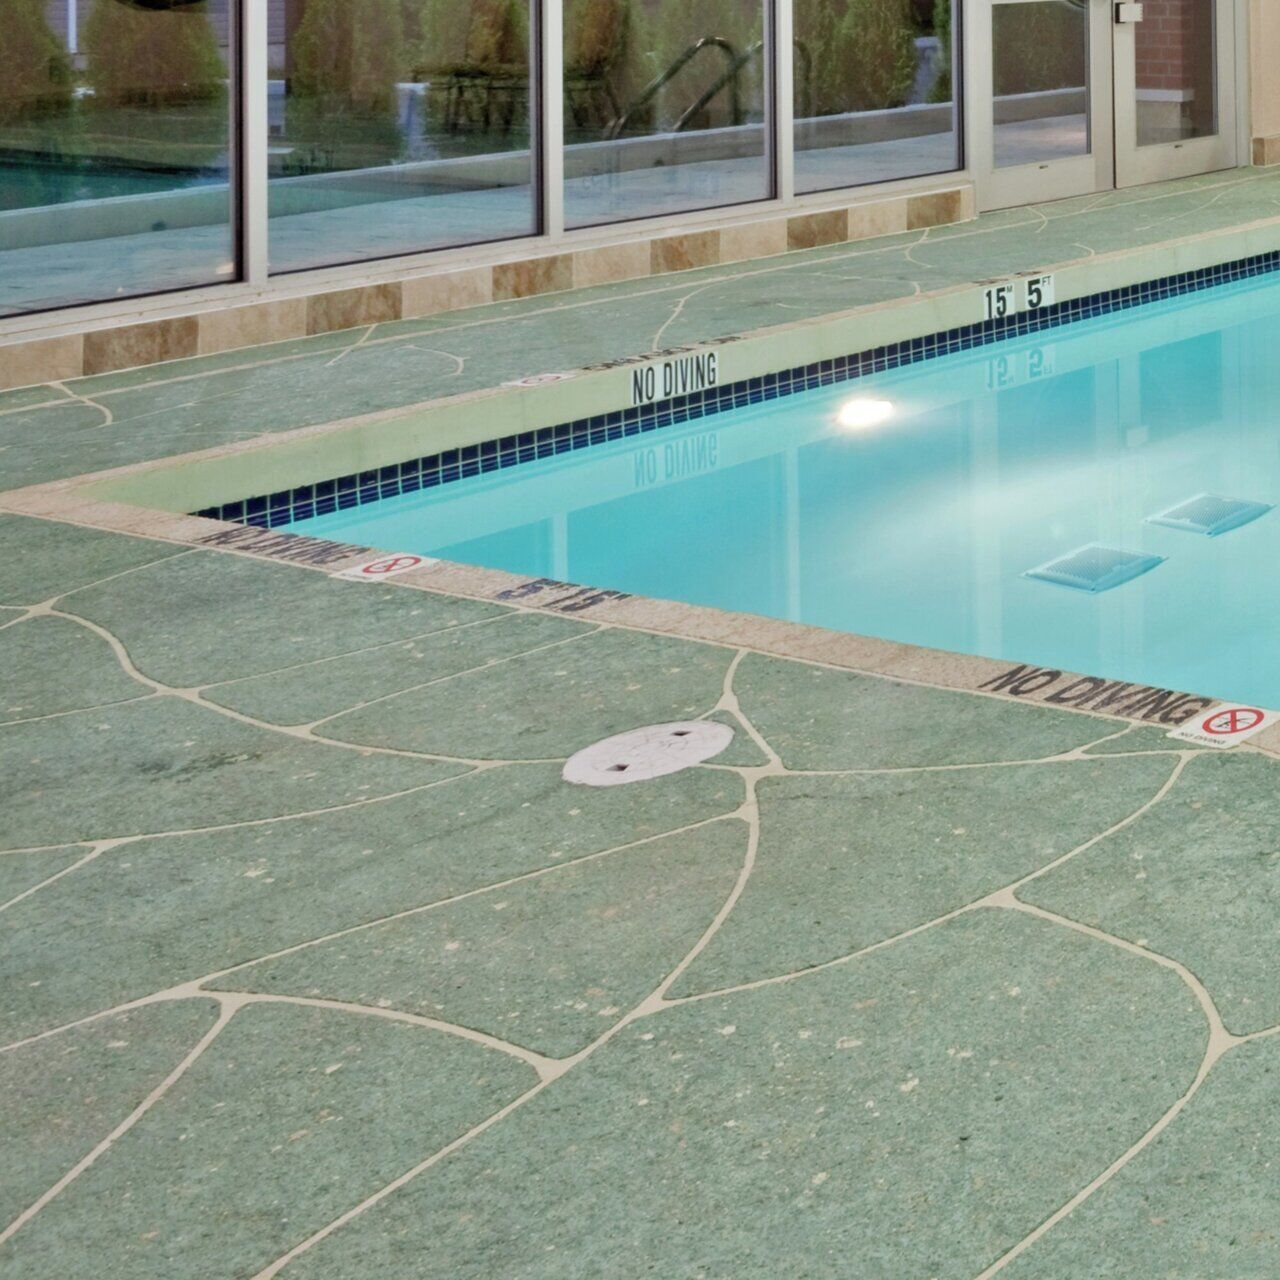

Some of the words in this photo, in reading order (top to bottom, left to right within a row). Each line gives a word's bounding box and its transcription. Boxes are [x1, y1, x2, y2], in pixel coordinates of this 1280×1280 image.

[633, 366, 655, 405] NO
[664, 352, 716, 397] DIVING
[977, 664, 1061, 695] NO
[1044, 676, 1212, 725] DIVING
